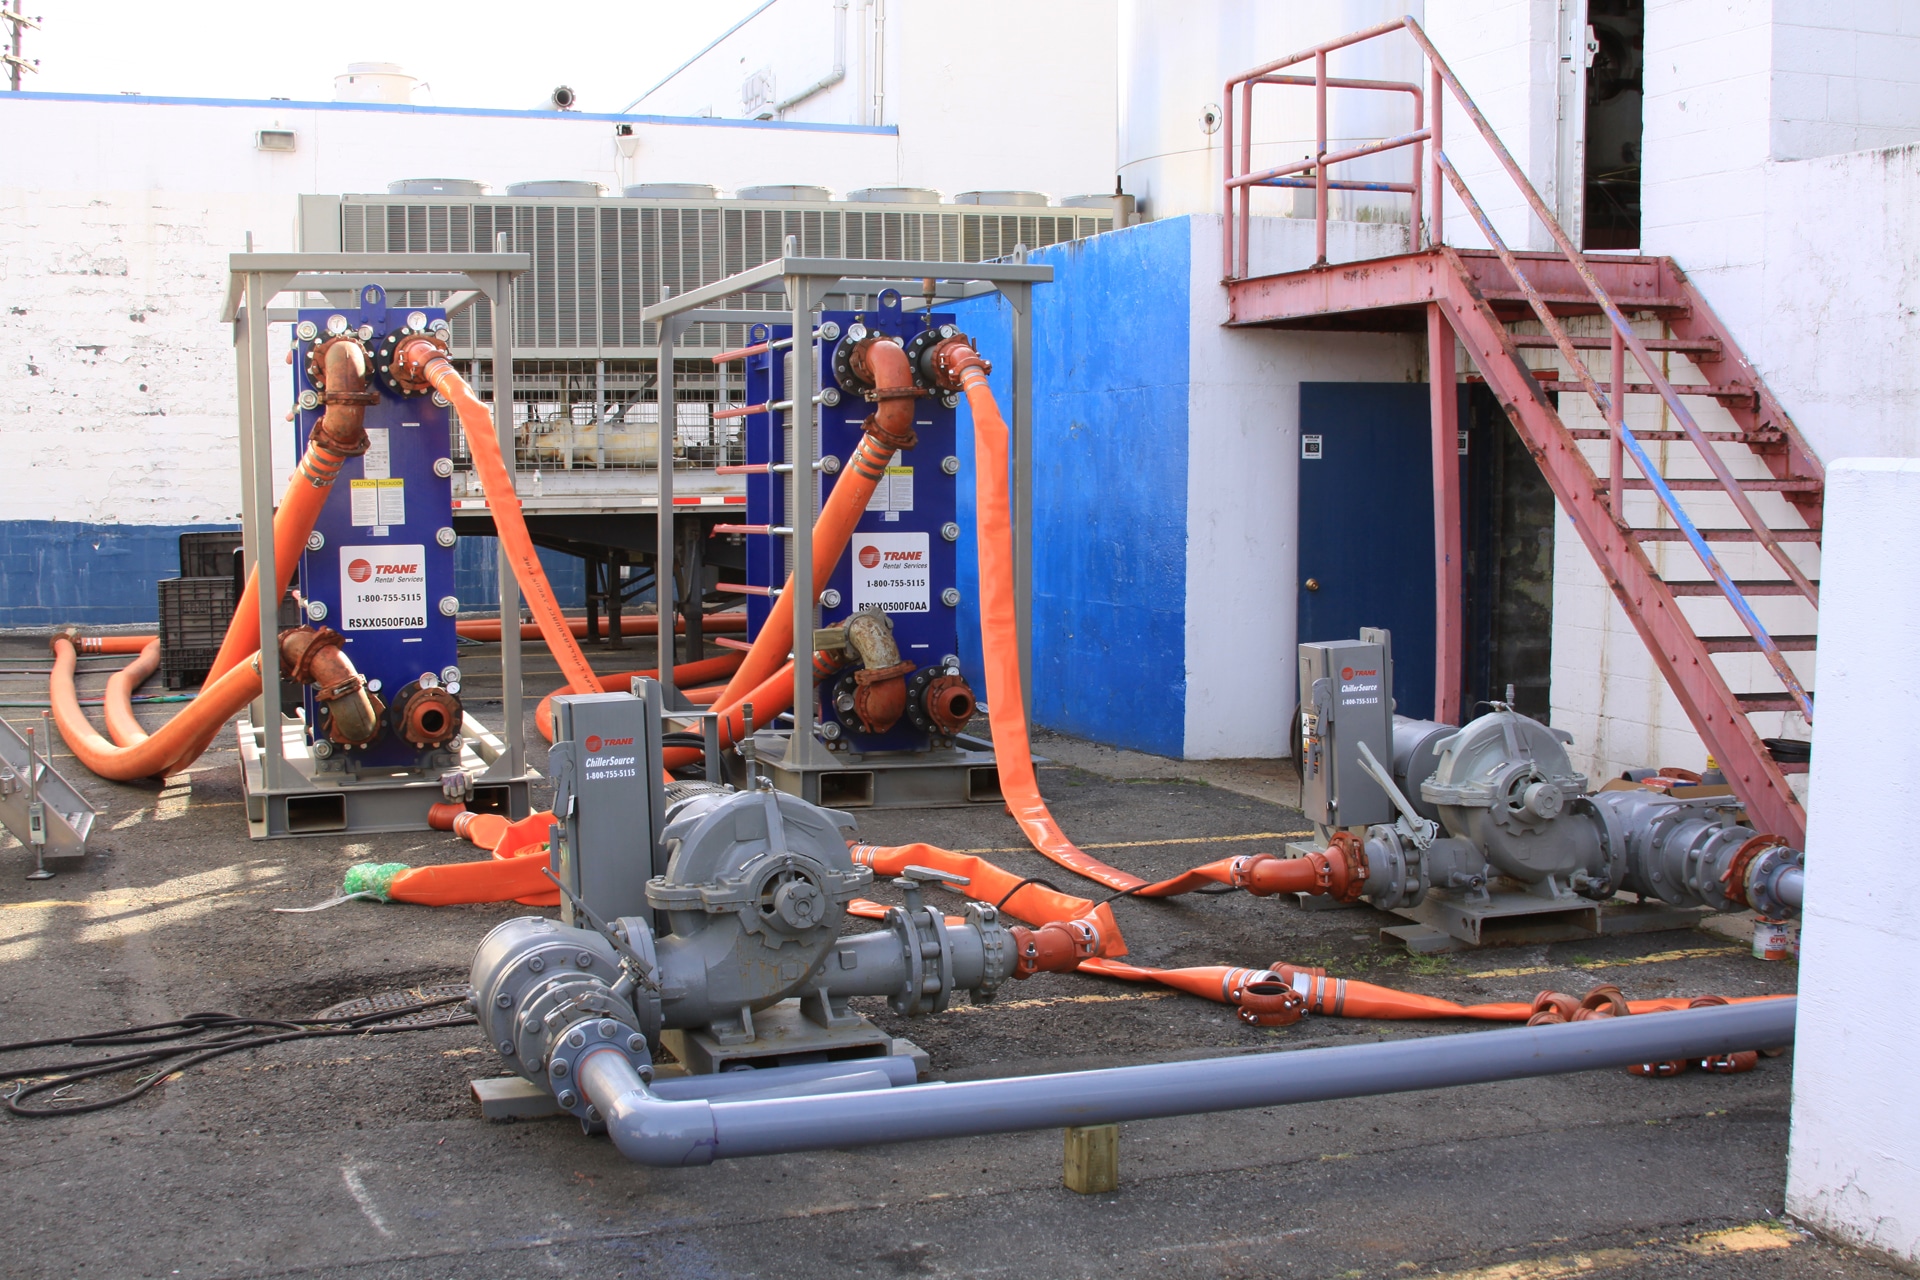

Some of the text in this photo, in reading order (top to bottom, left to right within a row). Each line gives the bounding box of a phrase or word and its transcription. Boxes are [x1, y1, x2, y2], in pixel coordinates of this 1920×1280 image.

[884, 551, 922, 561] TRANE
[375, 564, 418, 574] TRANE
[374, 576, 395, 584] Rental
[867, 579, 925, 588] 1-800-755-5115
[357, 593, 422, 603] 1-800-755-5115
[349, 617, 424, 628] RSXX0500F0AB
[1341, 683, 1378, 693] ChillerSource
[1342, 697, 1378, 705] 1-800-755-5115
[603, 737, 634, 747] TRANE
[585, 755, 635, 768] ChillerSource
[585, 768, 636, 780] 1-800-755-5115
